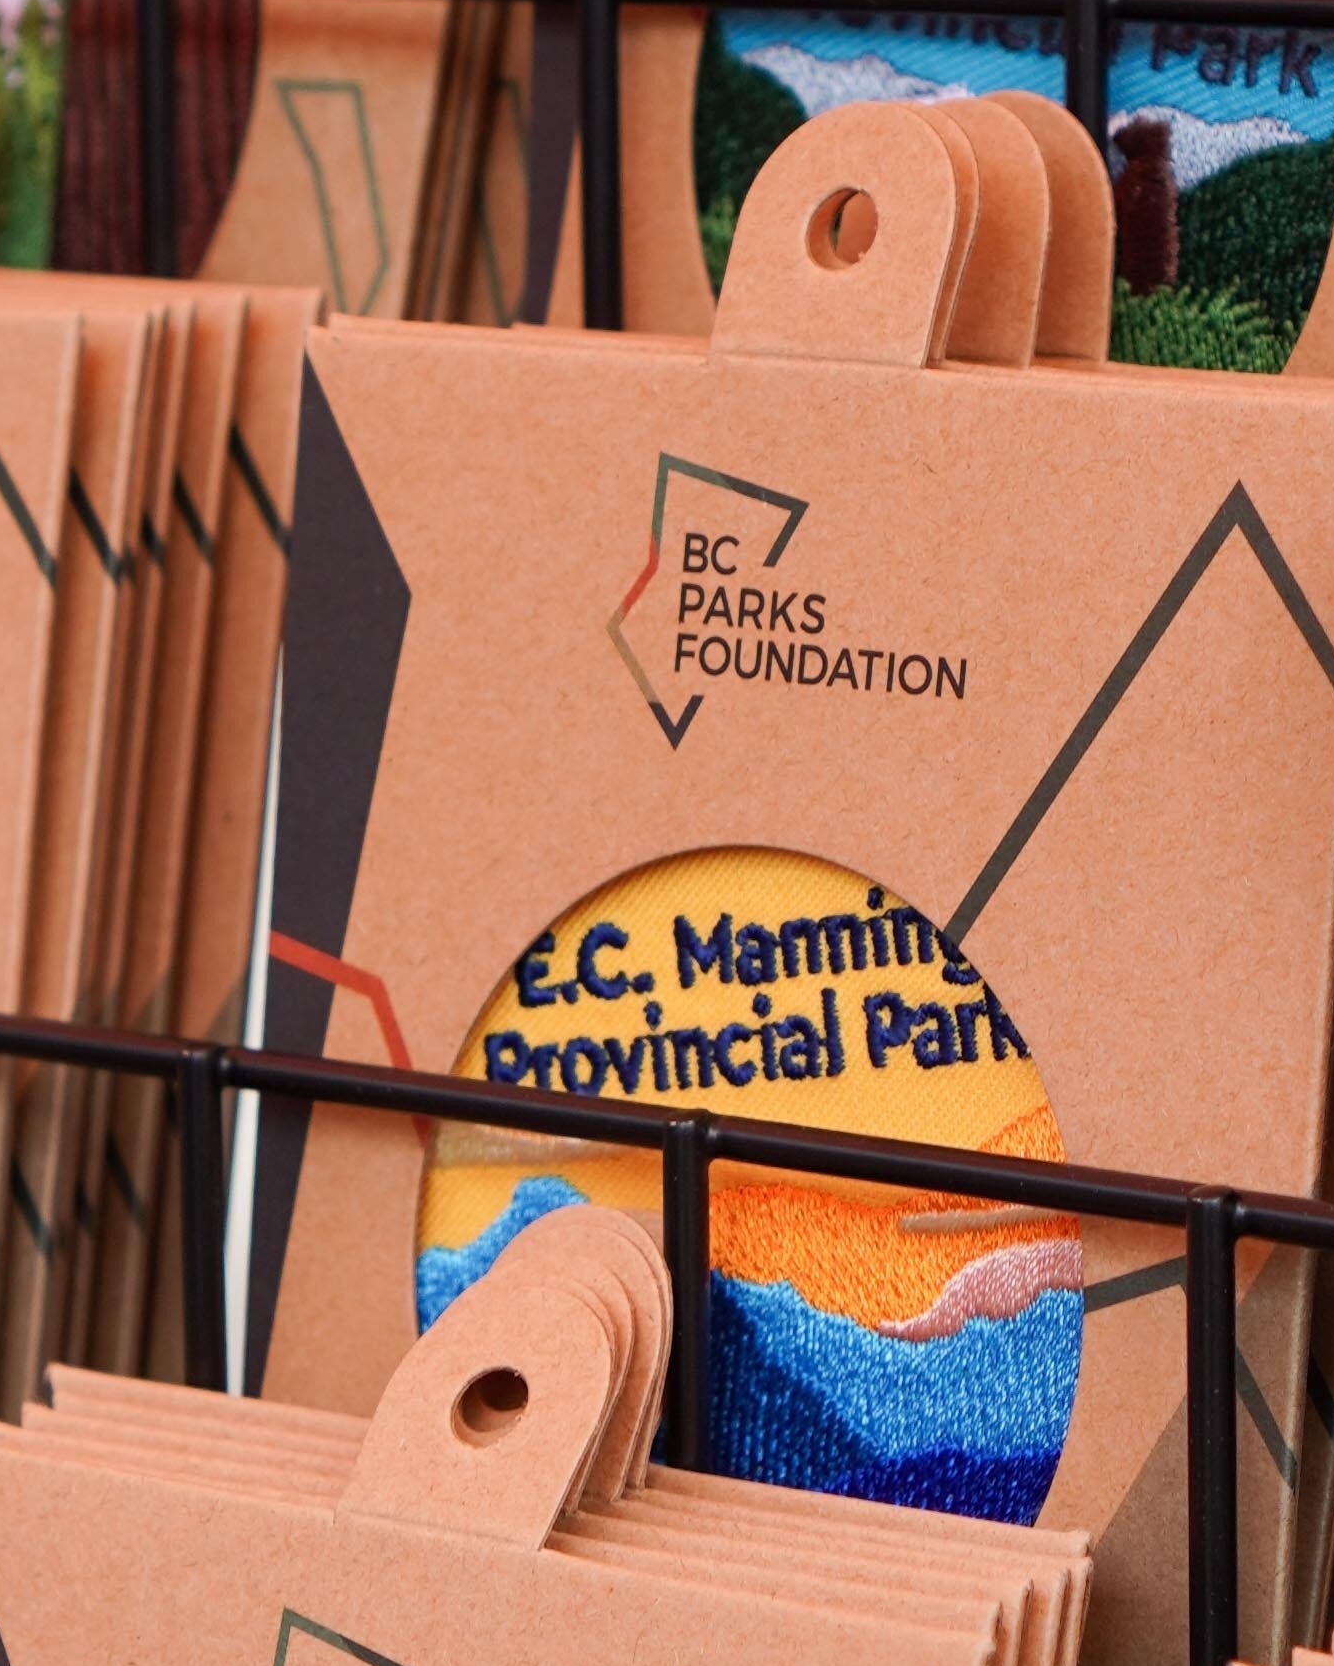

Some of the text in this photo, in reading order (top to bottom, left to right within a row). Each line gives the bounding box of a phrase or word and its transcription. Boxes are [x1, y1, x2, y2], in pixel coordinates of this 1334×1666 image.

[682, 532, 740, 575] BC
[678, 582, 827, 634] PARKS
[674, 632, 968, 700] FOUNDATION
[515, 922, 656, 1008] E.C.
[485, 982, 1032, 1097] Provincial Park
